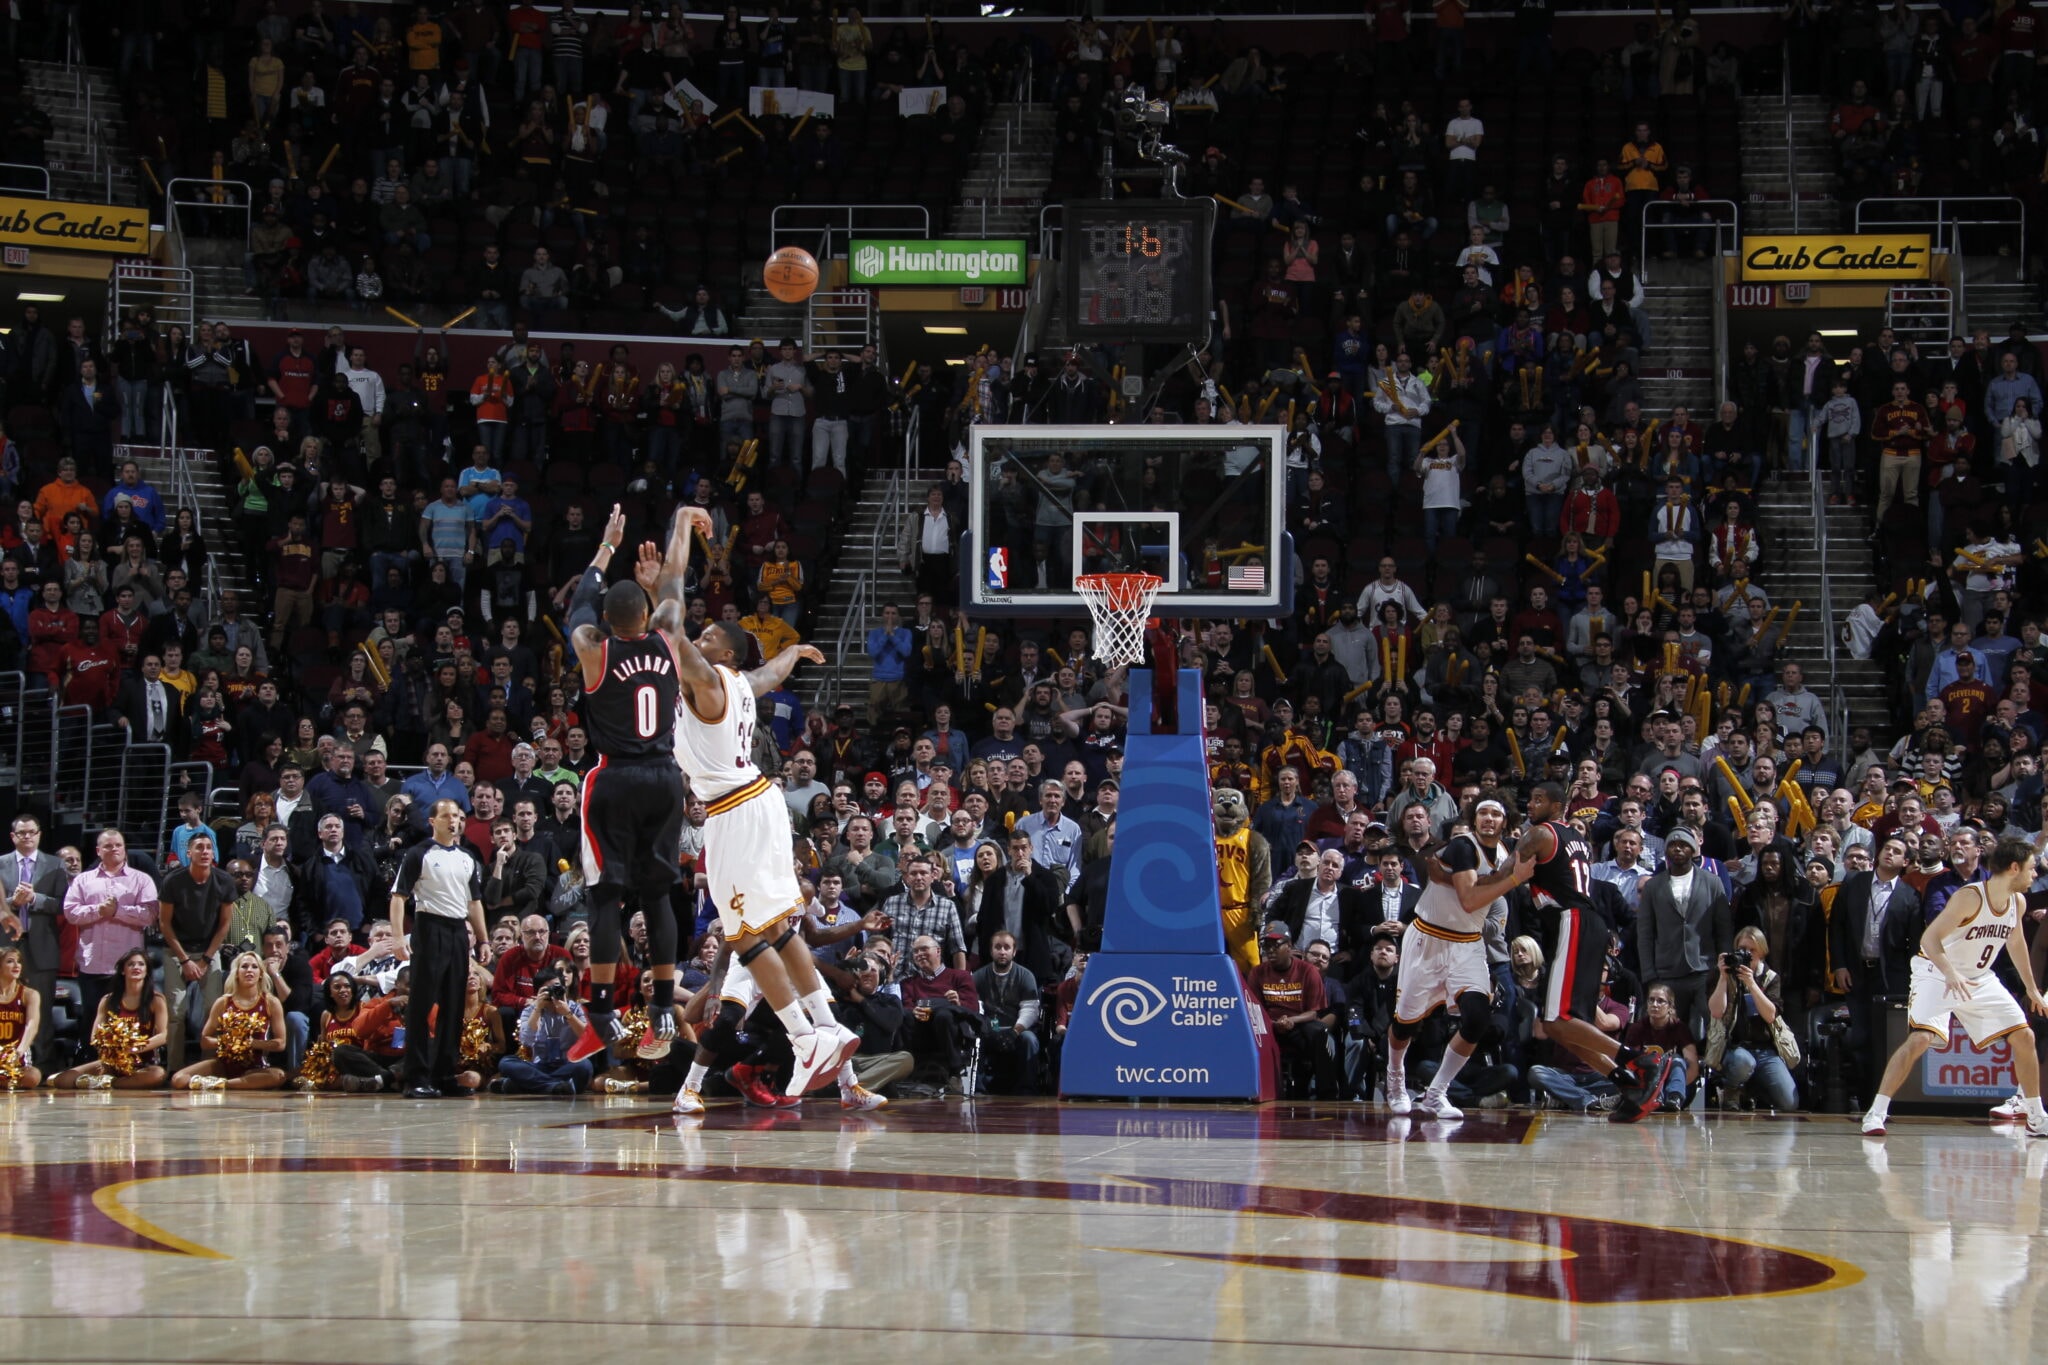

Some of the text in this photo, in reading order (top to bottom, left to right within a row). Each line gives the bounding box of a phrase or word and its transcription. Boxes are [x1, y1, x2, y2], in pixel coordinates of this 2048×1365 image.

[0, 209, 144, 243] ub Cadet
[6, 248, 26, 265] EXIT
[889, 246, 1019, 279] Huntington
[1746, 244, 1925, 271] Cub Cadet
[963, 288, 983, 302] EXIT
[1732, 286, 1770, 307] 100
[1788, 284, 1808, 299] EXIT
[713, 582, 721, 595] 2
[981, 596, 1012, 604] SPALDING
[612, 655, 671, 682] LILLARD
[1948, 689, 1985, 702] CLEVELAND
[634, 683, 660, 740] 0
[1962, 698, 1971, 713] 2
[1216, 844, 1246, 863] AVS
[1977, 944, 1993, 970] 9
[1171, 976, 1217, 993] Time
[1171, 993, 1238, 1010] Warner
[1170, 1010, 1223, 1027] Cable
[1116, 1063, 1209, 1083] twc.com
[1953, 1088, 2000, 1097] FOOD FAIR
